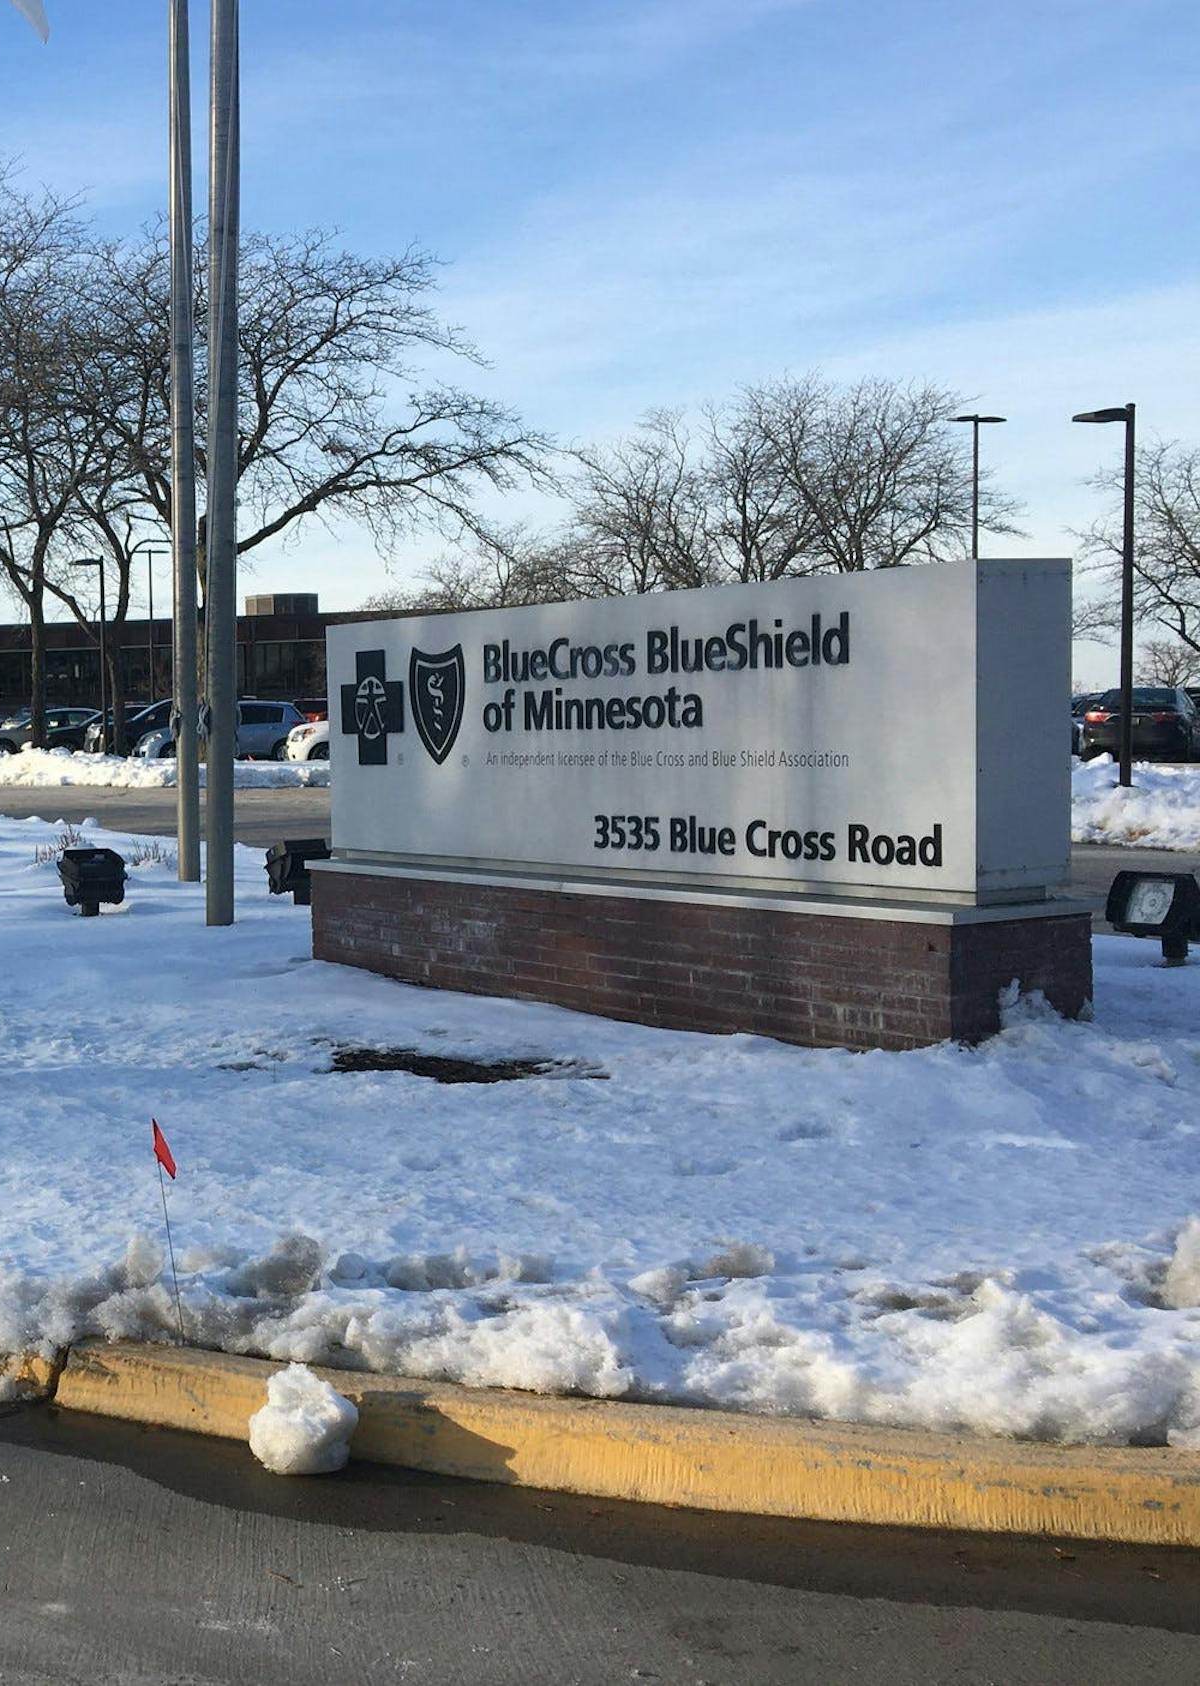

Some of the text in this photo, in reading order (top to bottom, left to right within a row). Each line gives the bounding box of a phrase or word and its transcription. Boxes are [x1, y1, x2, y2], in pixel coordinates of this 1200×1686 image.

[483, 611, 850, 682] BlueCross BlueShield
[483, 687, 703, 733] of Minnesota
[486, 750, 849, 768] An independent licensee of the Blue Cross and Blue Shield Association
[594, 815, 942, 866] 3535 Blue Cross Road
